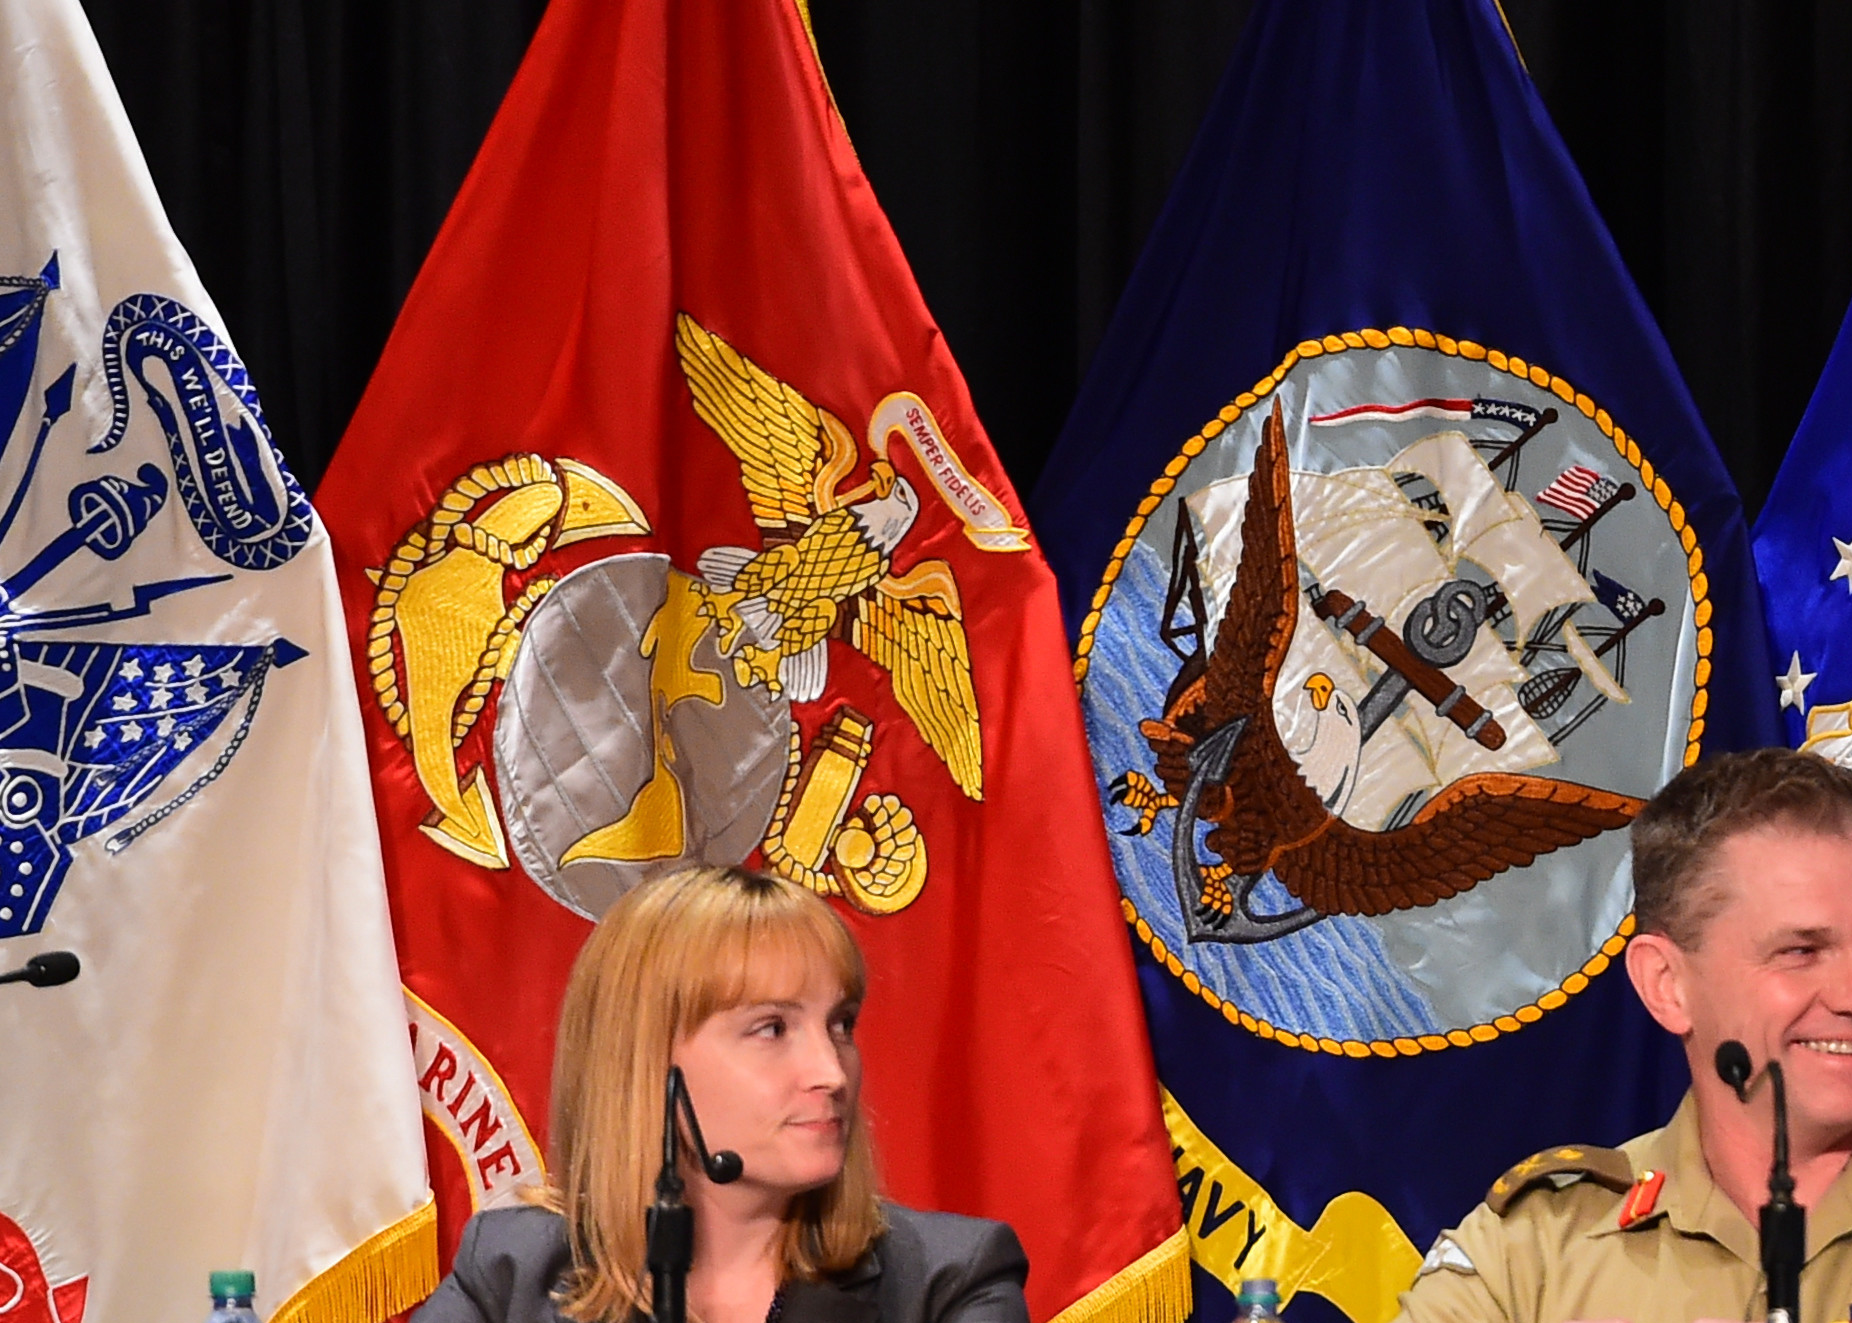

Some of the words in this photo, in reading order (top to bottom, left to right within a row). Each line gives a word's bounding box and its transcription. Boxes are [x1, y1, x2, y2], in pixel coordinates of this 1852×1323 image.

[135, 330, 185, 361] THIS
[181, 367, 216, 447] WE'LL
[204, 446, 253, 530] DEFEND
[905, 407, 945, 467] SEMPER
[938, 466, 987, 517] FIDELIS
[408, 1022, 522, 1191] RINE
[1172, 1146, 1267, 1270] AVY
